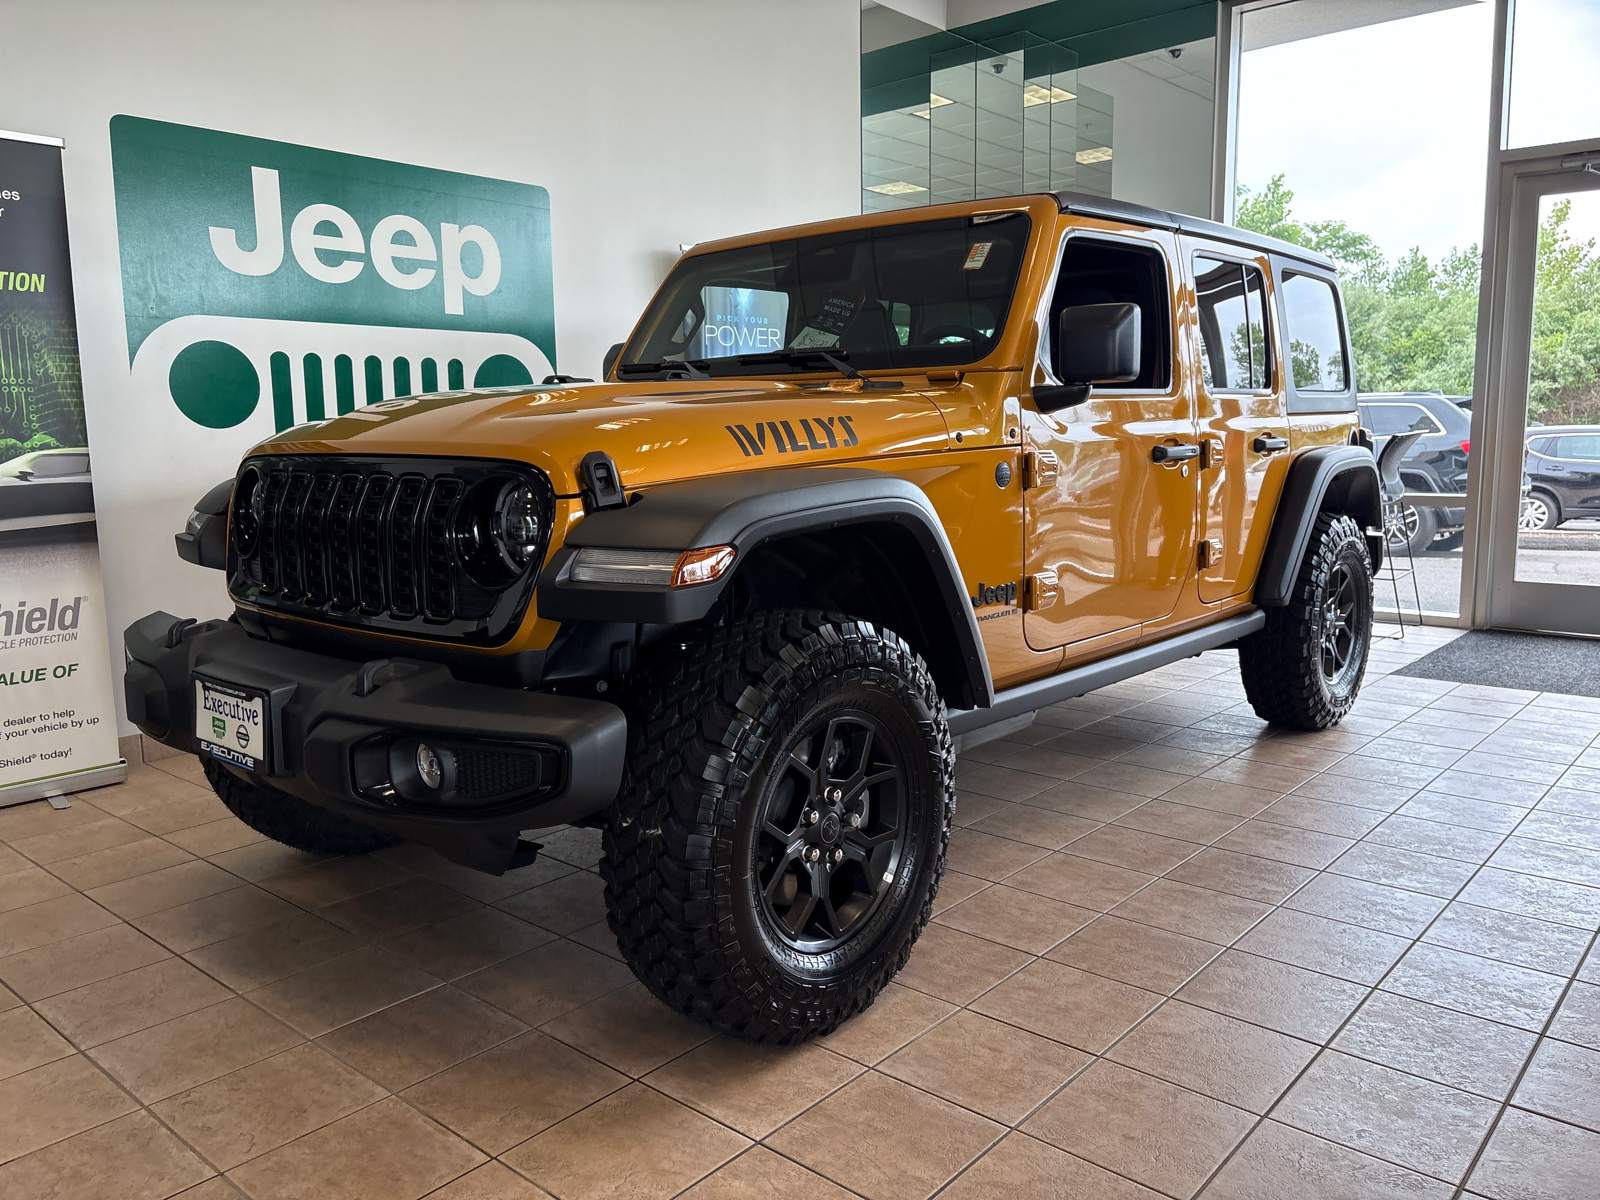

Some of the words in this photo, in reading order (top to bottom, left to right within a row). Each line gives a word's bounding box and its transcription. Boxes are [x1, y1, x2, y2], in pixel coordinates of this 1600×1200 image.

[209, 166, 501, 315] Jeep
[823, 304, 841, 314] MADE
[841, 309, 851, 317] US
[828, 297, 855, 309] AMERICA
[716, 314, 739, 323] PICK
[745, 316, 769, 325] YOUR
[705, 325, 782, 348] POWER
[725, 415, 859, 457] WILLYS
[971, 581, 1017, 607] Jeep
[19, 632, 78, 647] PROTECTION
[53, 663, 79, 679] OF
[203, 690, 259, 725] Executive
[3, 716, 36, 727] dealer
[53, 709, 75, 719] help
[5, 728, 28, 740] your
[32, 722, 68, 734] vehicle
[71, 719, 83, 728] by
[86, 717, 99, 725] up
[40, 747, 72, 760] today!
[200, 740, 254, 768] EXECUTIVE
